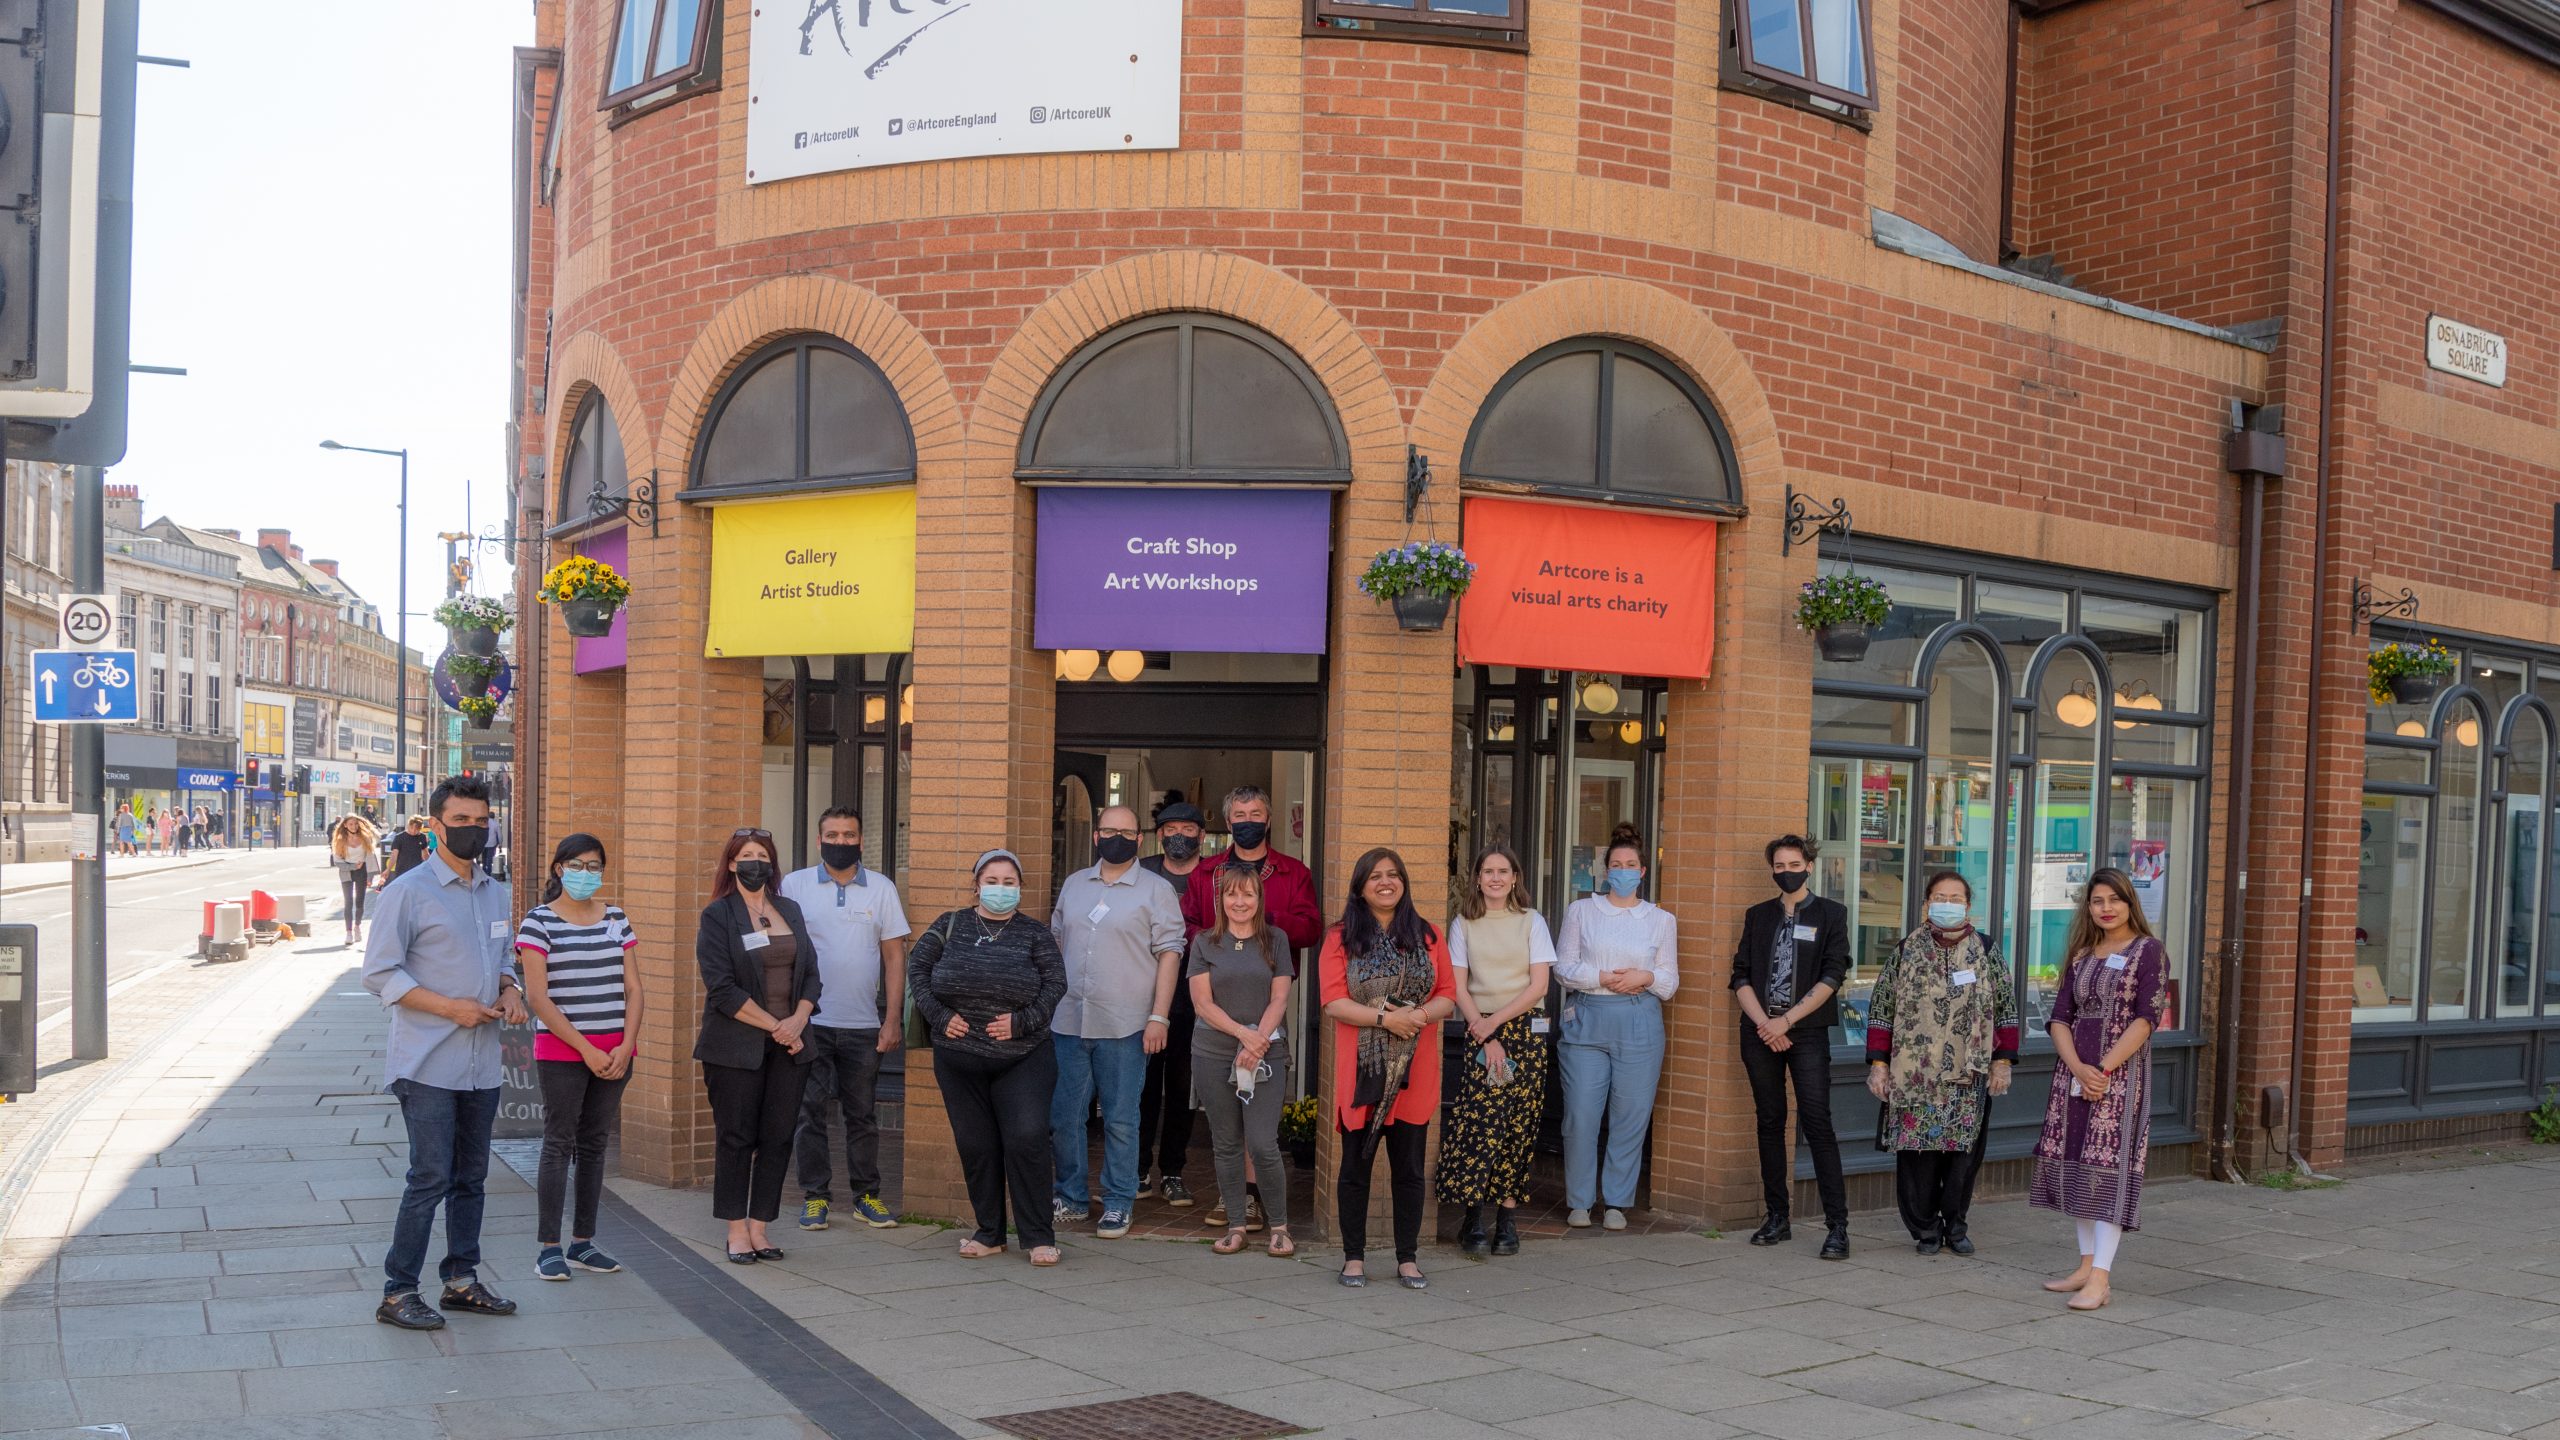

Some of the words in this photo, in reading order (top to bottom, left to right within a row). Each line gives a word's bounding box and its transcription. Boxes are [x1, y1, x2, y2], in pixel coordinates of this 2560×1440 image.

[907, 112, 997, 132] @ArtcoreEngland
[1049, 106, 1112, 122] /ArtcoreUK
[810, 127, 860, 145] /ArtcoreUK
[2437, 323, 2500, 359] OSNABRÜCK
[2447, 348, 2488, 375] SQUARE
[785, 548, 838, 567] Gallery
[1126, 537, 1180, 555] Craft
[1186, 537, 1238, 560] Shop
[1538, 559, 1610, 582] Artcore
[1615, 566, 1629, 583] is
[1633, 572, 1645, 585] a
[760, 583, 802, 600] Artist
[806, 580, 860, 598] Studios
[1103, 572, 1140, 590] Art
[1143, 572, 1258, 596] Workshops
[1511, 587, 1562, 606] visual
[1567, 593, 1602, 609] arts
[1607, 594, 1669, 619] charity
[71, 611, 103, 631] 20
[105, 772, 131, 781] ERKINS
[189, 774, 220, 786] CORAL
